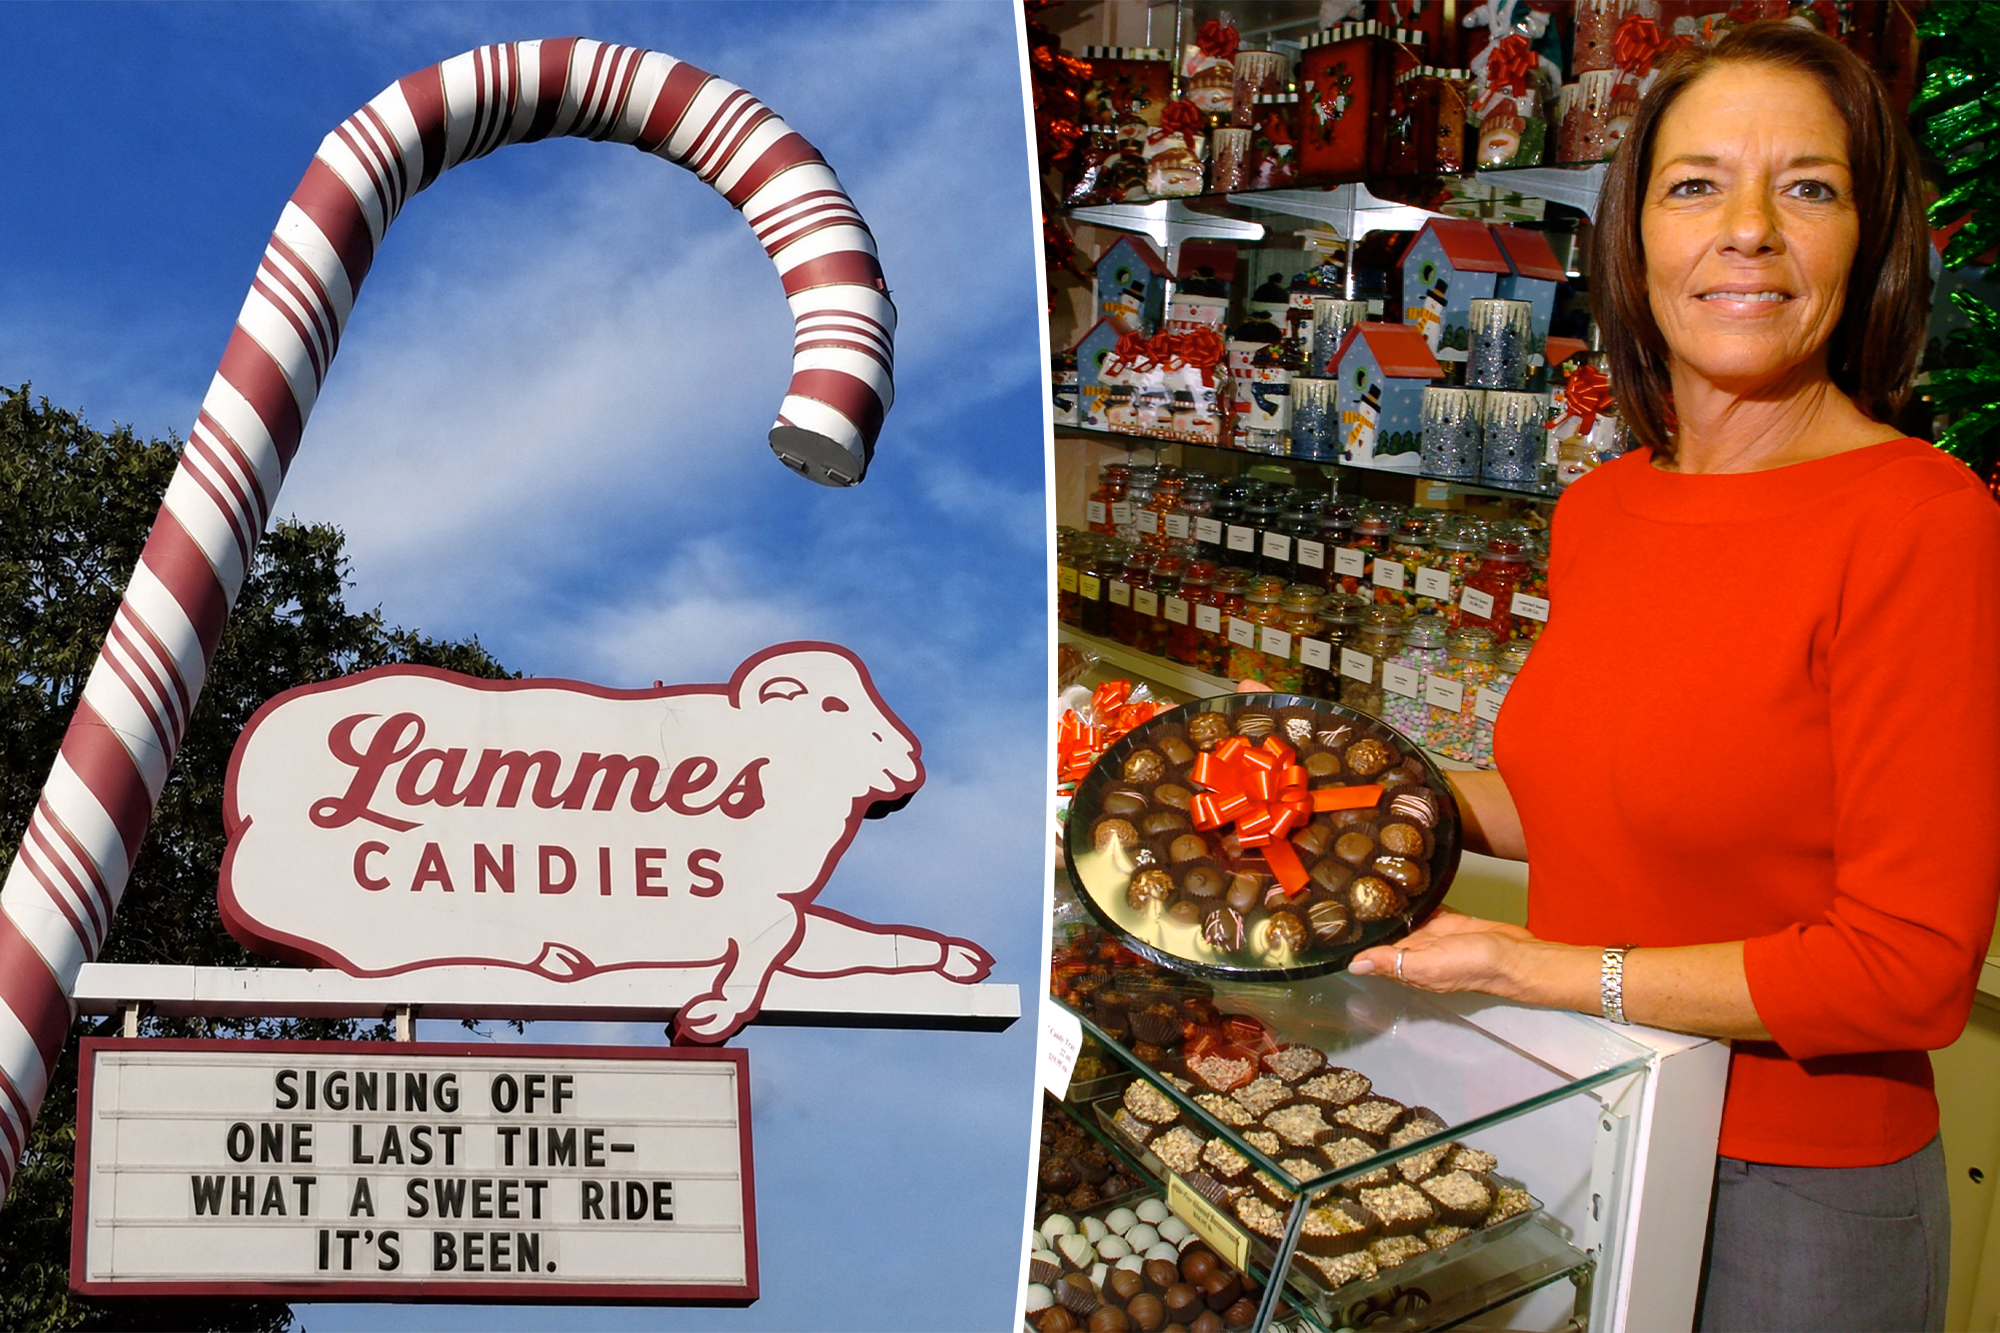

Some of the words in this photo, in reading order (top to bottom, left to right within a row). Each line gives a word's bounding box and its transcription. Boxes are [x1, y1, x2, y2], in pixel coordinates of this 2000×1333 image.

[309, 713, 771, 832] Lammes
[353, 841, 725, 898] CANDIES
[275, 1069, 459, 1113] SIGNING
[491, 1074, 575, 1114] OFF
[226, 1122, 314, 1163] ONE
[352, 1124, 464, 1166] LAST
[191, 1175, 317, 1216] WHAT
[349, 1177, 376, 1217] A
[406, 1178, 549, 1220] SWEET
[581, 1181, 674, 1221] RIDE
[318, 1229, 400, 1272] IT'S
[433, 1231, 558, 1273] BEEN.
